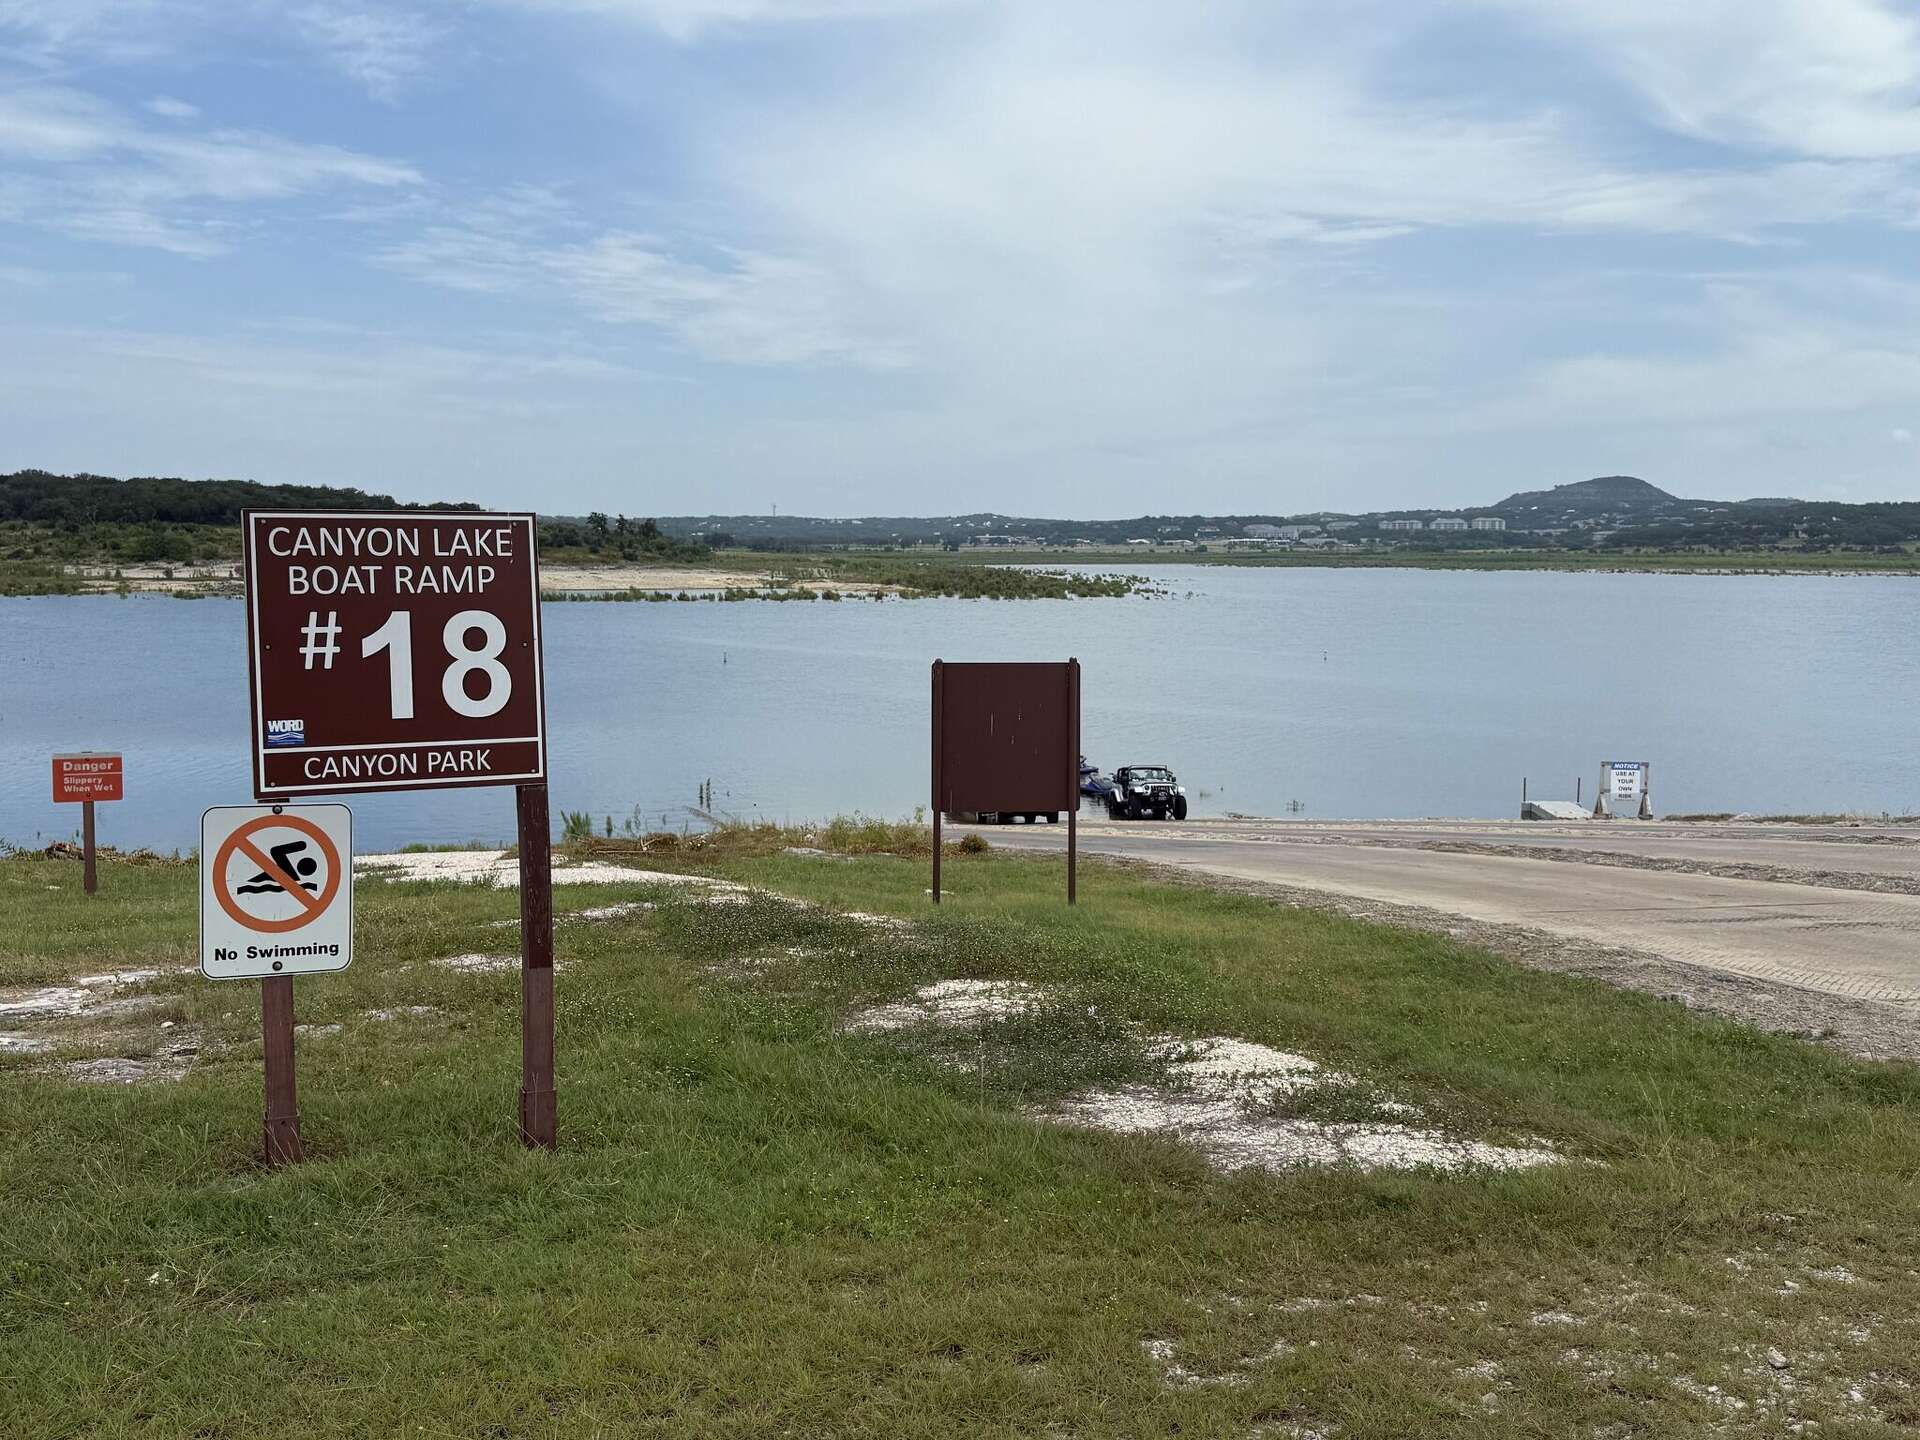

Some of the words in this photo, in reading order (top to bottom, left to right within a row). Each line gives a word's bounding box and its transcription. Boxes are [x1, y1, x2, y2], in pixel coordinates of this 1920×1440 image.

[268, 527, 418, 557] CANYON
[433, 528, 513, 557] LAKE
[288, 565, 383, 595] BOAT
[395, 565, 496, 594] RAMP
[267, 719, 304, 733] WORD
[63, 761, 114, 772] Danger
[304, 752, 417, 779] CANYON
[427, 749, 492, 773] PARK
[63, 776, 103, 785] Slippery
[64, 785, 91, 793] When
[214, 948, 238, 962] No
[246, 943, 340, 960] Swimming
